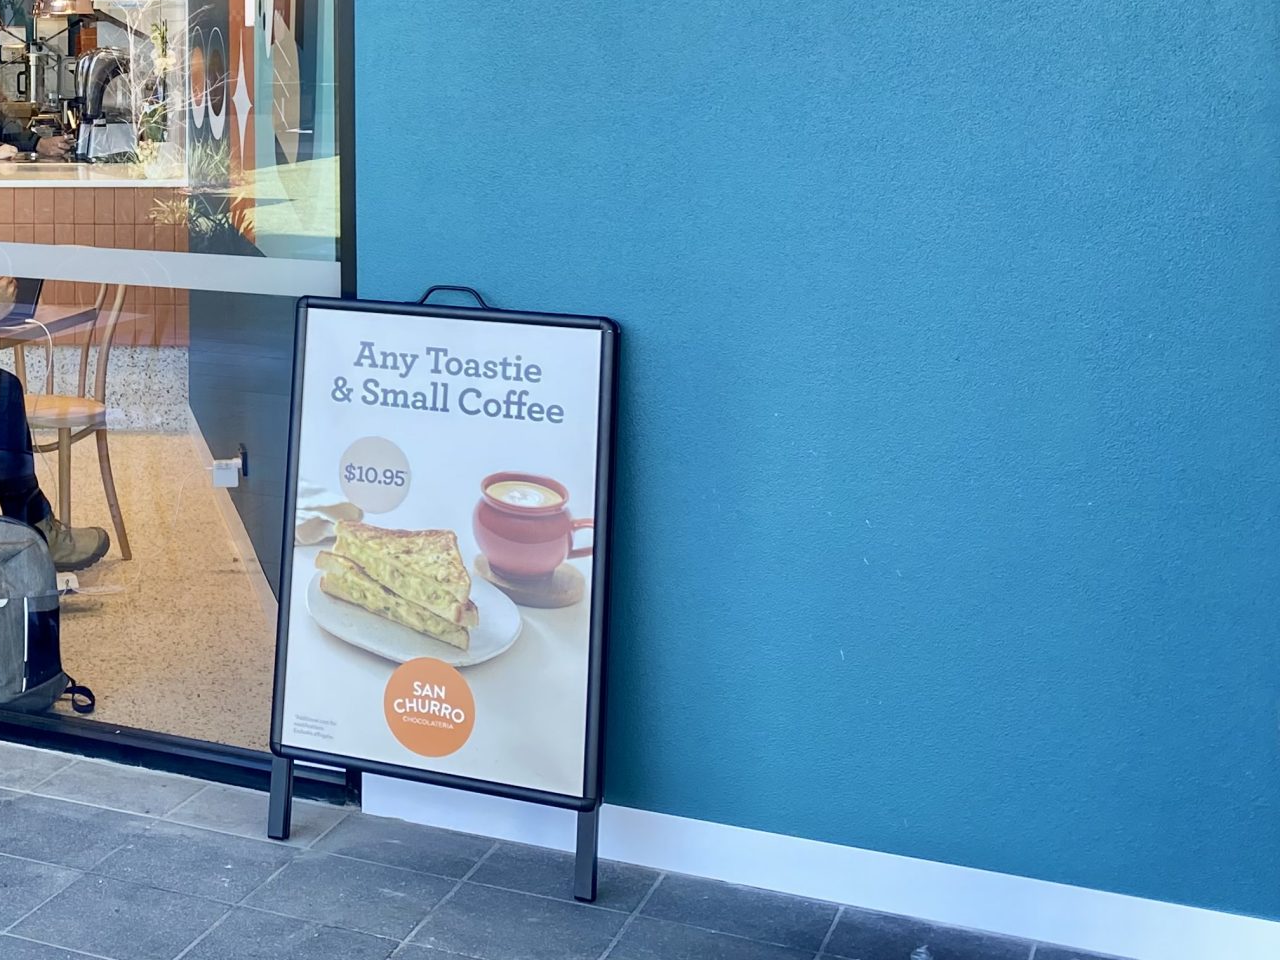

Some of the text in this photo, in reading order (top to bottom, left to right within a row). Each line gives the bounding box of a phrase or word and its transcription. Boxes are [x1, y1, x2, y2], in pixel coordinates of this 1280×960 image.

[353, 340, 542, 384] Any Toastie
[331, 376, 565, 424] & Small Coffee
[413, 681, 445, 700] SAN
[393, 698, 465, 724] CHURRO
[402, 715, 455, 730] CHOCOLATERIA
